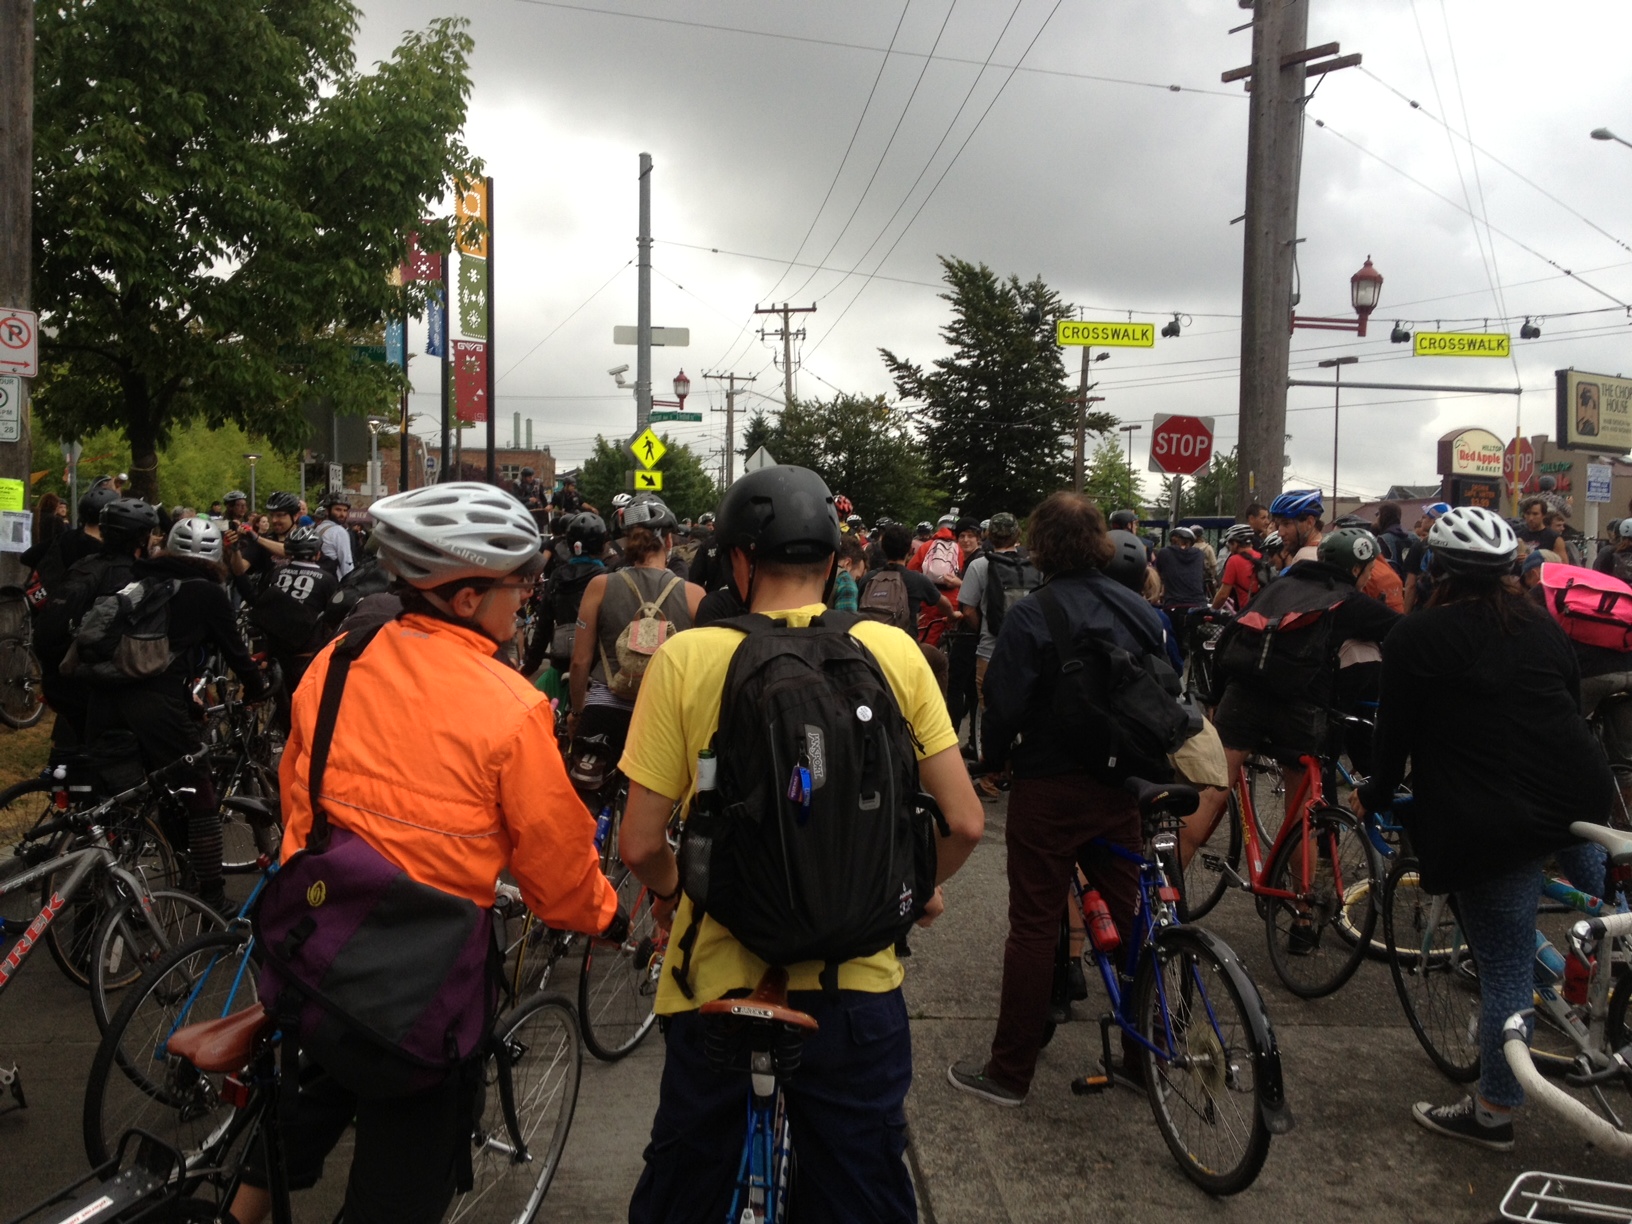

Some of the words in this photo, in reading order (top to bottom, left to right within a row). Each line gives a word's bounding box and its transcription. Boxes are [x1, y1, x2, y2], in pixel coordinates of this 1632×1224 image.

[1062, 326, 1150, 341] CROSSWALK
[1419, 337, 1506, 351] CROSSWALK
[1601, 383, 1613, 397] THE
[1606, 398, 1628, 414] HOUSE
[1155, 432, 1209, 457] STOP
[1459, 449, 1475, 461] Red
[1477, 451, 1501, 465] Apple
[1476, 465, 1501, 473] MARKET
[1540, 461, 1573, 473] HILLTOP
[450, 544, 487, 566] GIRO
[808, 732, 824, 780] JANSPORT
[0, 891, 65, 988] TREK
